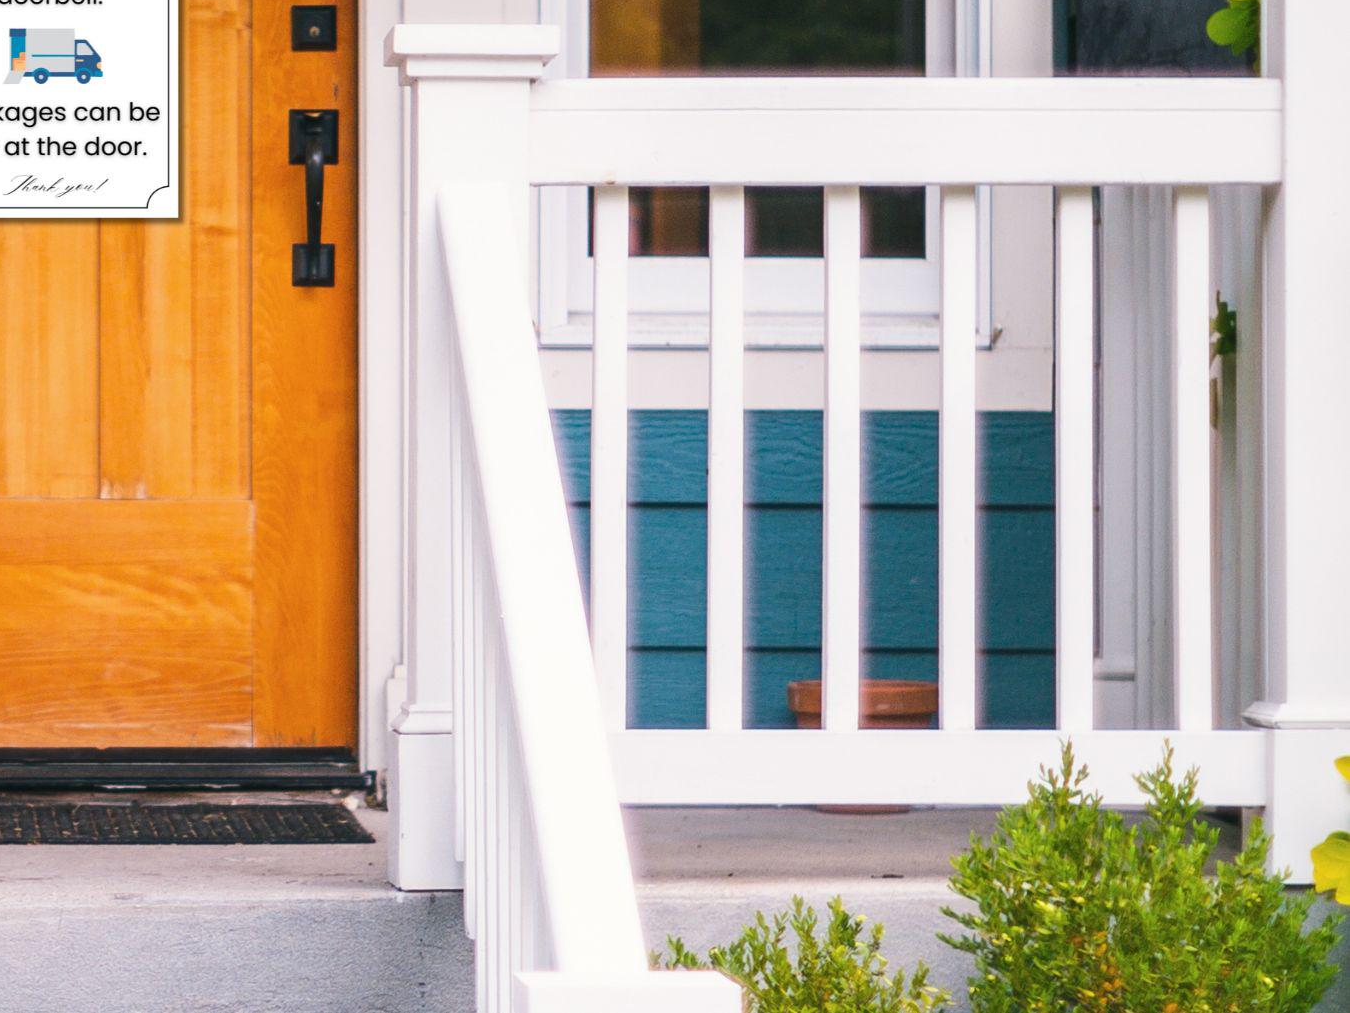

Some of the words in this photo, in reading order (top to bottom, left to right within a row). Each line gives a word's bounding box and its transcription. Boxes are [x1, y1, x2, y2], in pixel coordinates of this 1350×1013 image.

[73, 106, 121, 122] can
[129, 101, 161, 122] be
[4, 137, 30, 156] at
[36, 136, 77, 157] the
[84, 136, 148, 157] door.
[3, 174, 64, 195] Thank
[55, 178, 109, 198] you!
